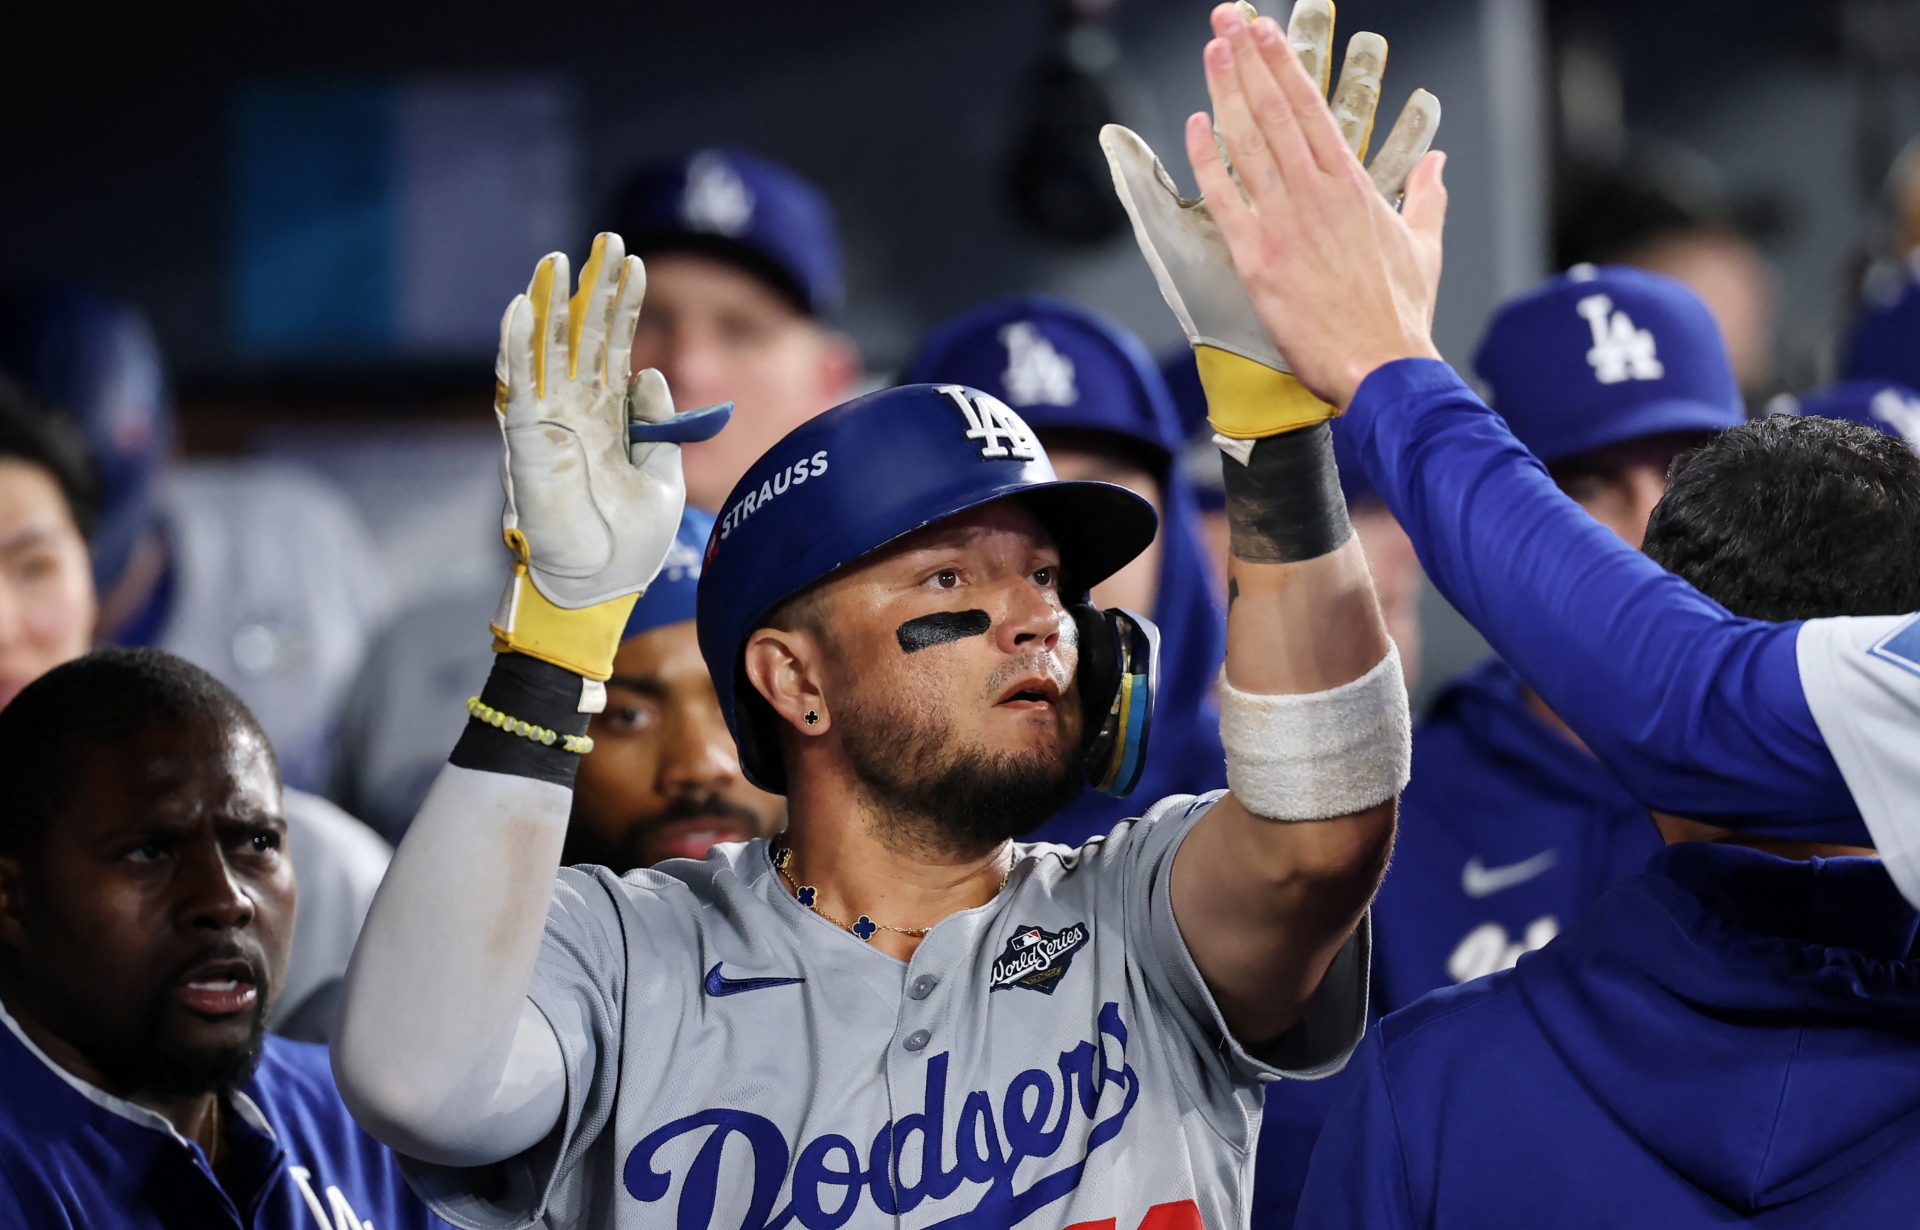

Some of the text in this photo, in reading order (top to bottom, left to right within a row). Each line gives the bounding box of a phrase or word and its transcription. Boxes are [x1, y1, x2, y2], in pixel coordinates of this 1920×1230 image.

[1000, 321, 1077, 406] LA
[1576, 293, 1664, 384] LA
[934, 384, 1035, 460] LA
[720, 450, 829, 540] STRAUSS
[990, 945, 1040, 987] World
[1035, 927, 1083, 971] Series
[623, 1002, 1140, 1230] Dodgers
